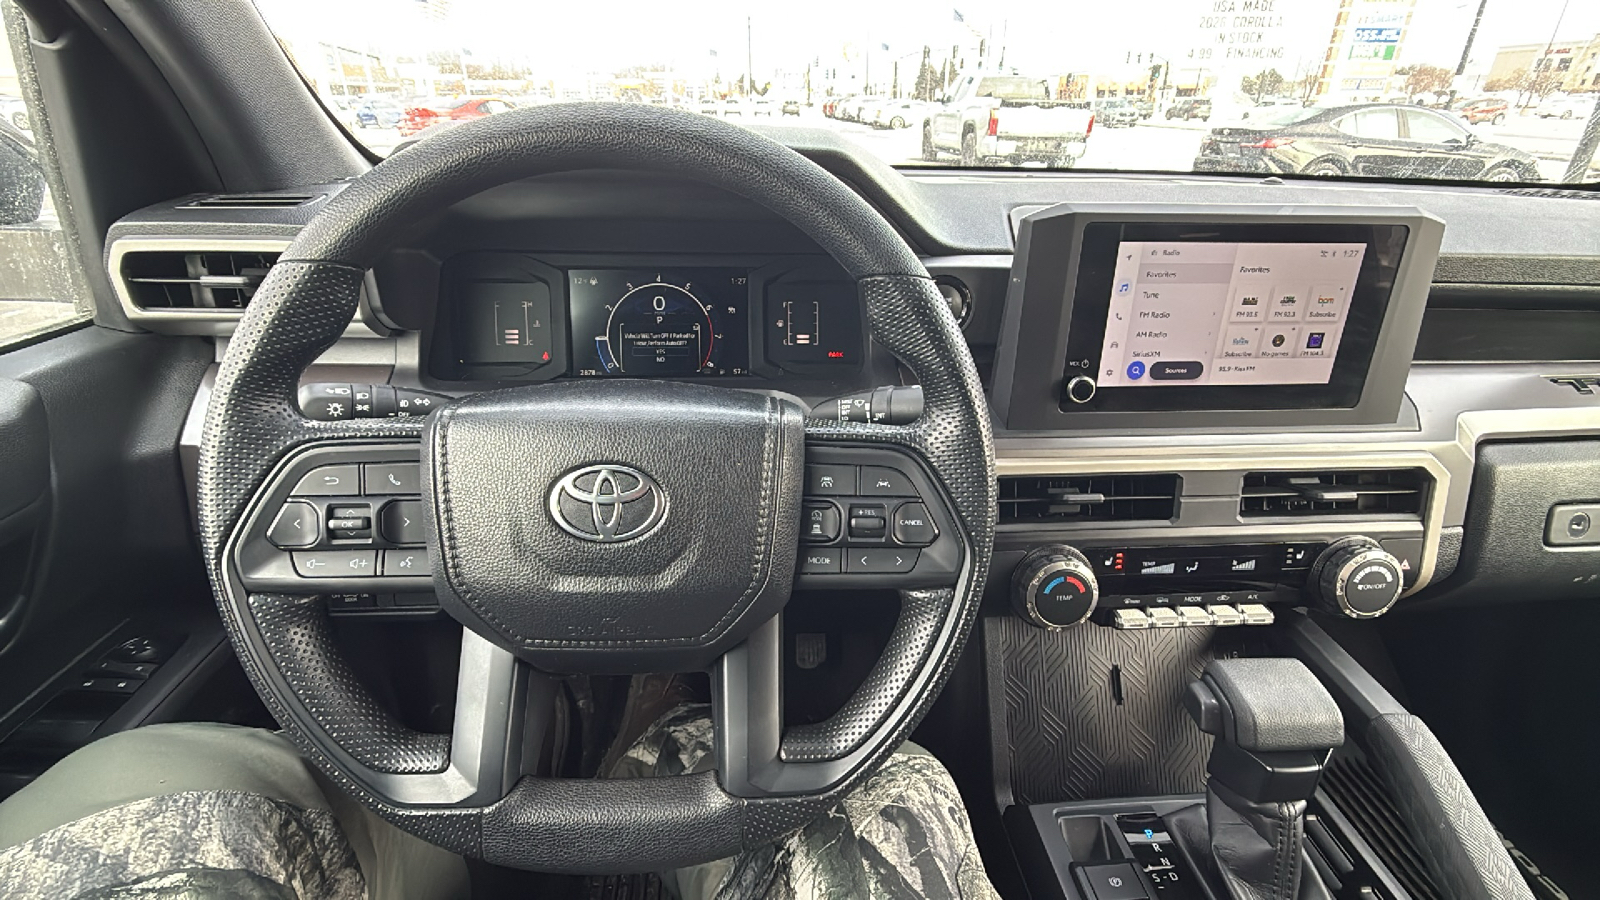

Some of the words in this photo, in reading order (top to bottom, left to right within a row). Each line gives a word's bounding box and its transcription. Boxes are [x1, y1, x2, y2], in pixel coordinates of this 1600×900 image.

[1213, 0, 1235, 13] USA
[1243, 0, 1275, 12] MADE
[1233, 16, 1283, 28] COROLLA
[1215, 32, 1225, 44] IN
[1229, 31, 1264, 44] STOCK
[1226, 47, 1284, 59] FINANCING
[684, 282, 692, 290] 5
[807, 556, 830, 564] MODE
[1144, 829, 1154, 839] P
[1152, 842, 1162, 852] R
[1160, 857, 1170, 865] N
[1152, 873, 1160, 882] S
[1168, 872, 1178, 880] D
